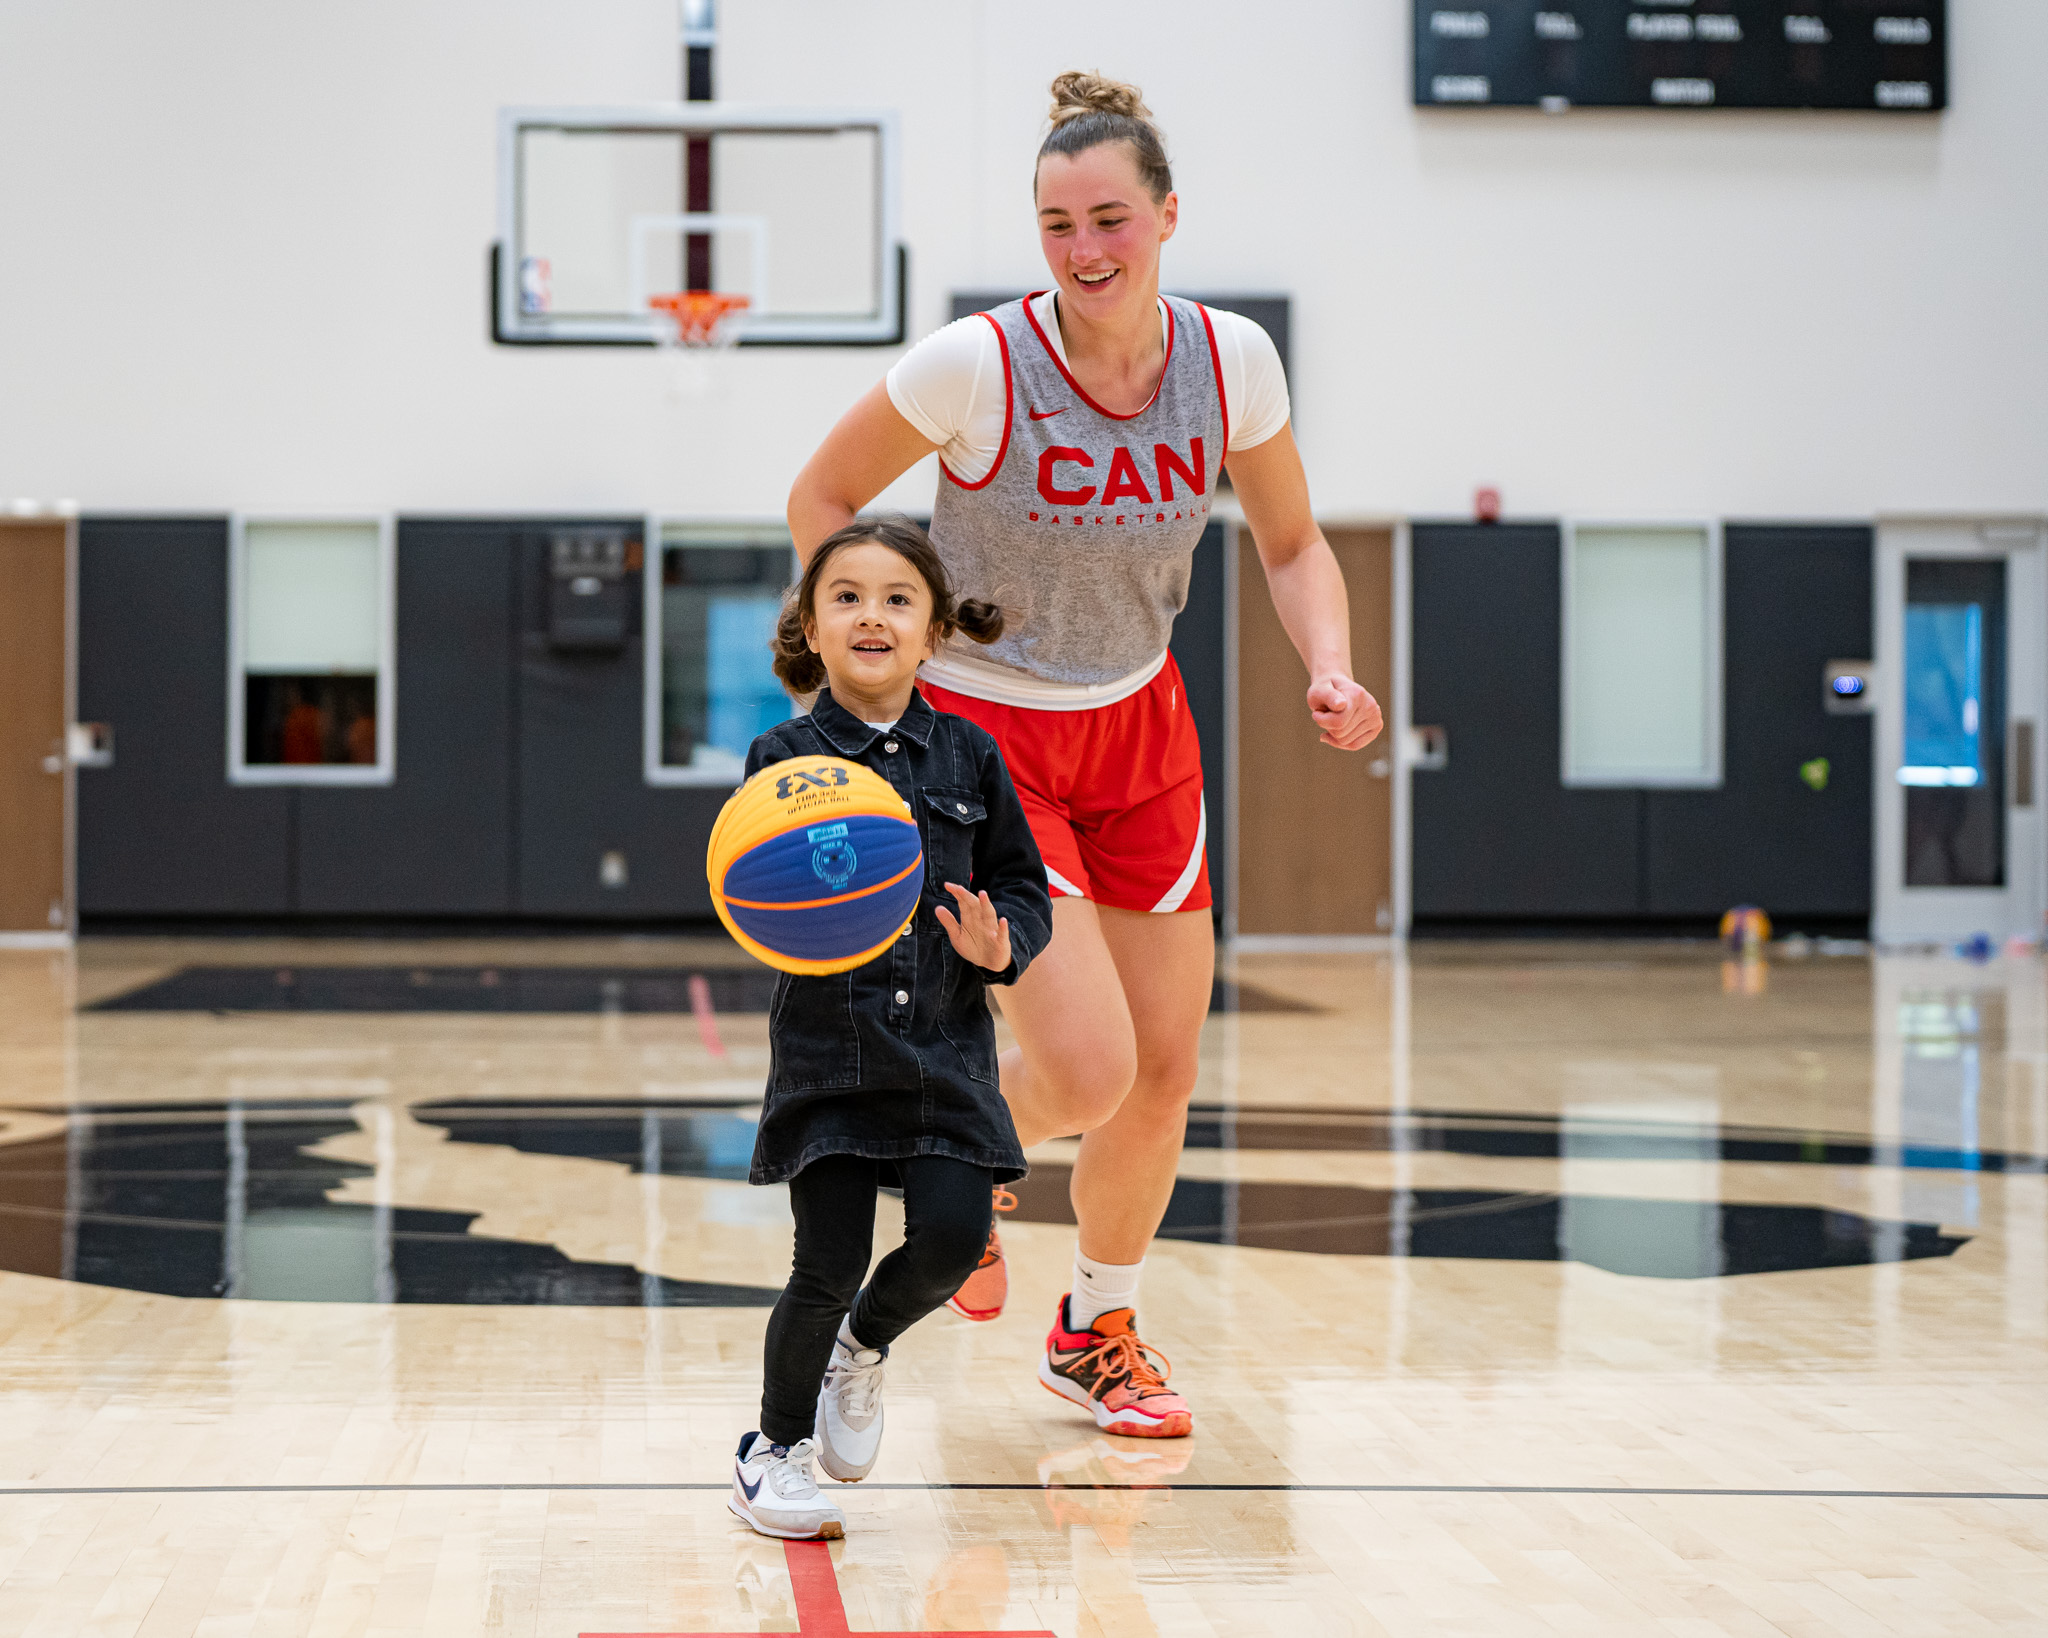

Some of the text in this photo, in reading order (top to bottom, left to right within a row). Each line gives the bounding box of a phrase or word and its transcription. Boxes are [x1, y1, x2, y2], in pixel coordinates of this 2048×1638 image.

[1037, 437, 1205, 505] CAN
[1029, 504, 1206, 526] BASKETBALL
[788, 798, 827, 815] OFFICIAL
